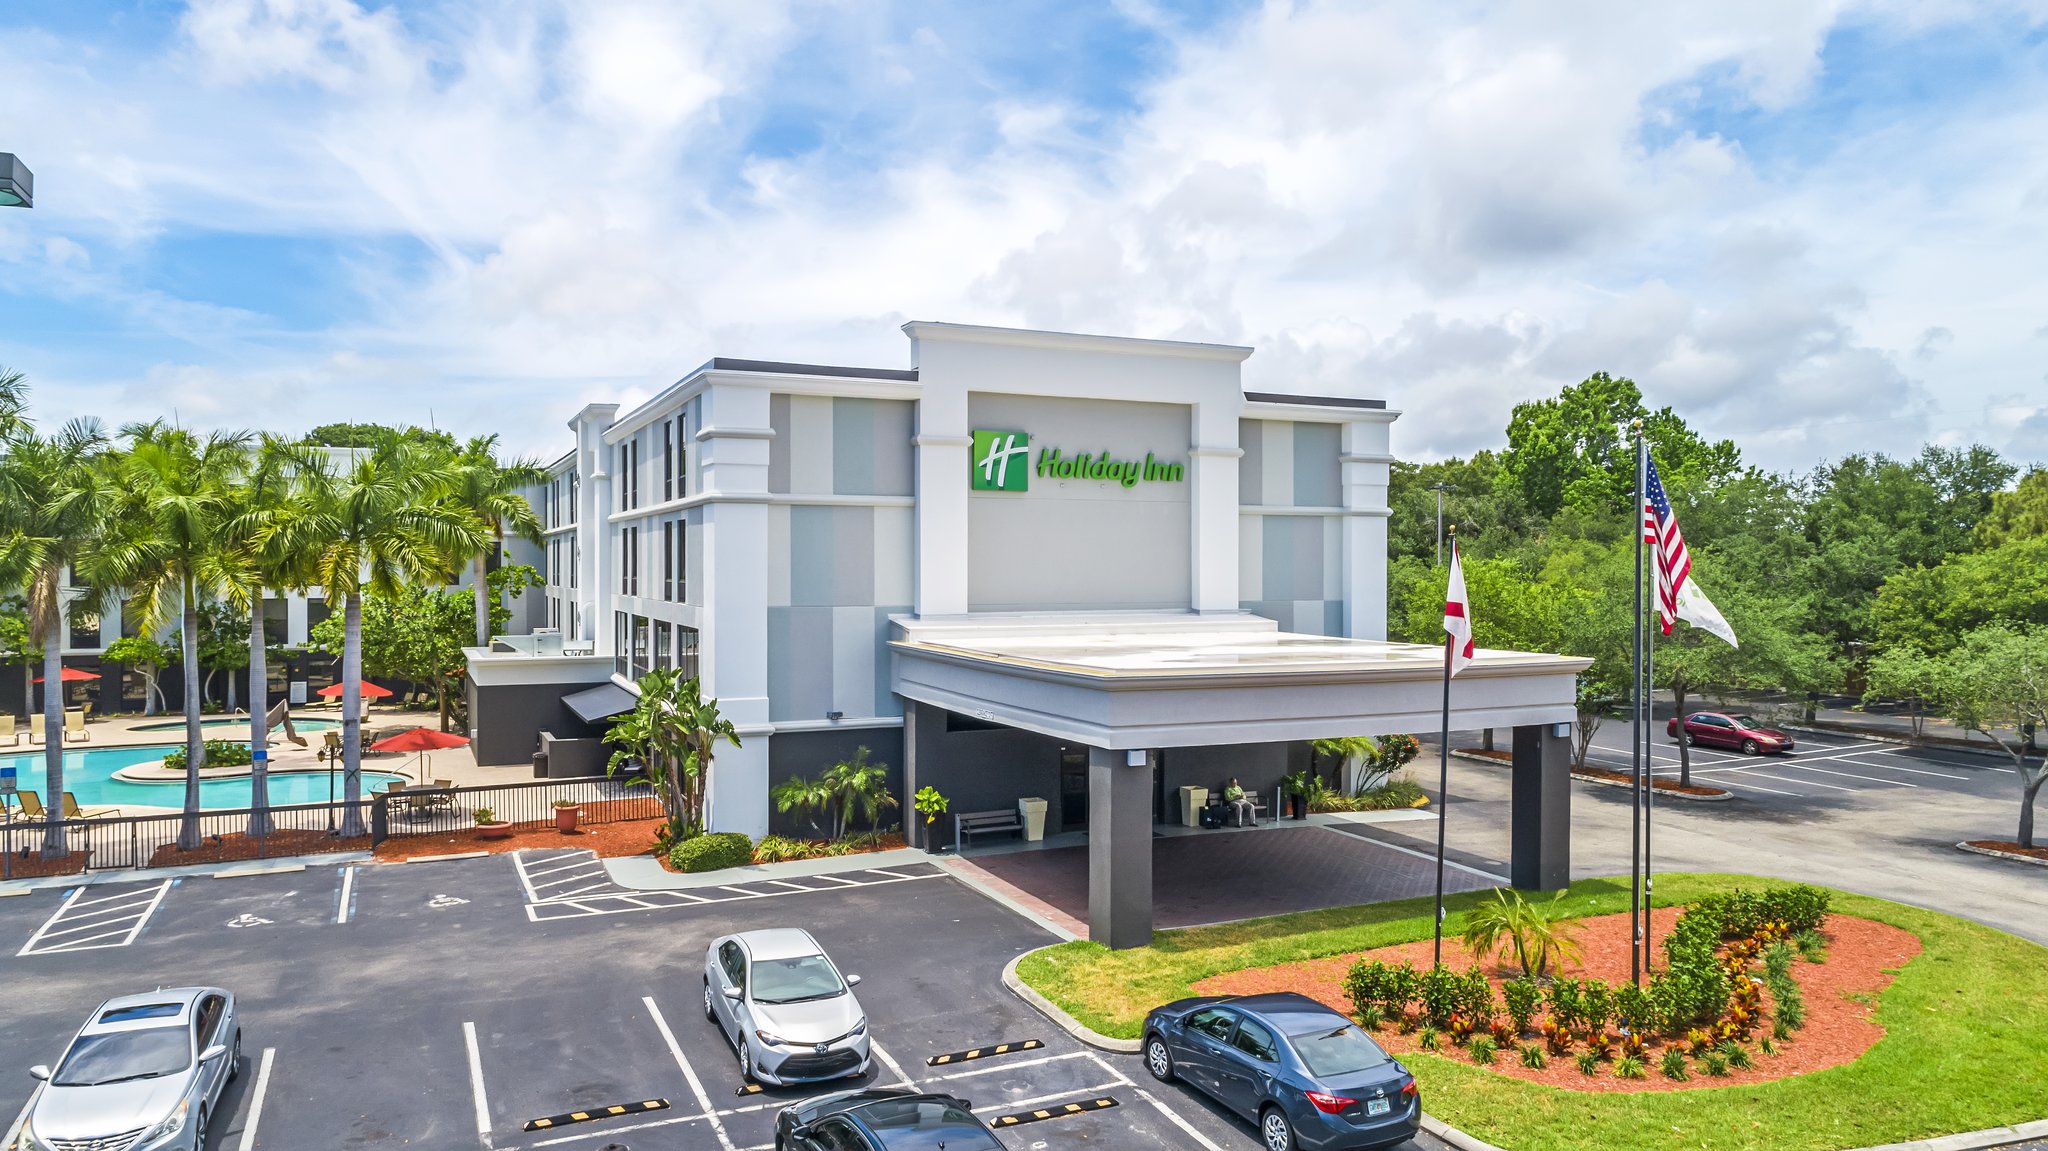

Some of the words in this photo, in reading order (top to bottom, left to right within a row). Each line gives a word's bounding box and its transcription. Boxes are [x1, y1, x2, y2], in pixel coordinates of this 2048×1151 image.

[979, 435, 1028, 487] H
[1037, 448, 1141, 488] Holiday
[1143, 453, 1184, 482] Inn
